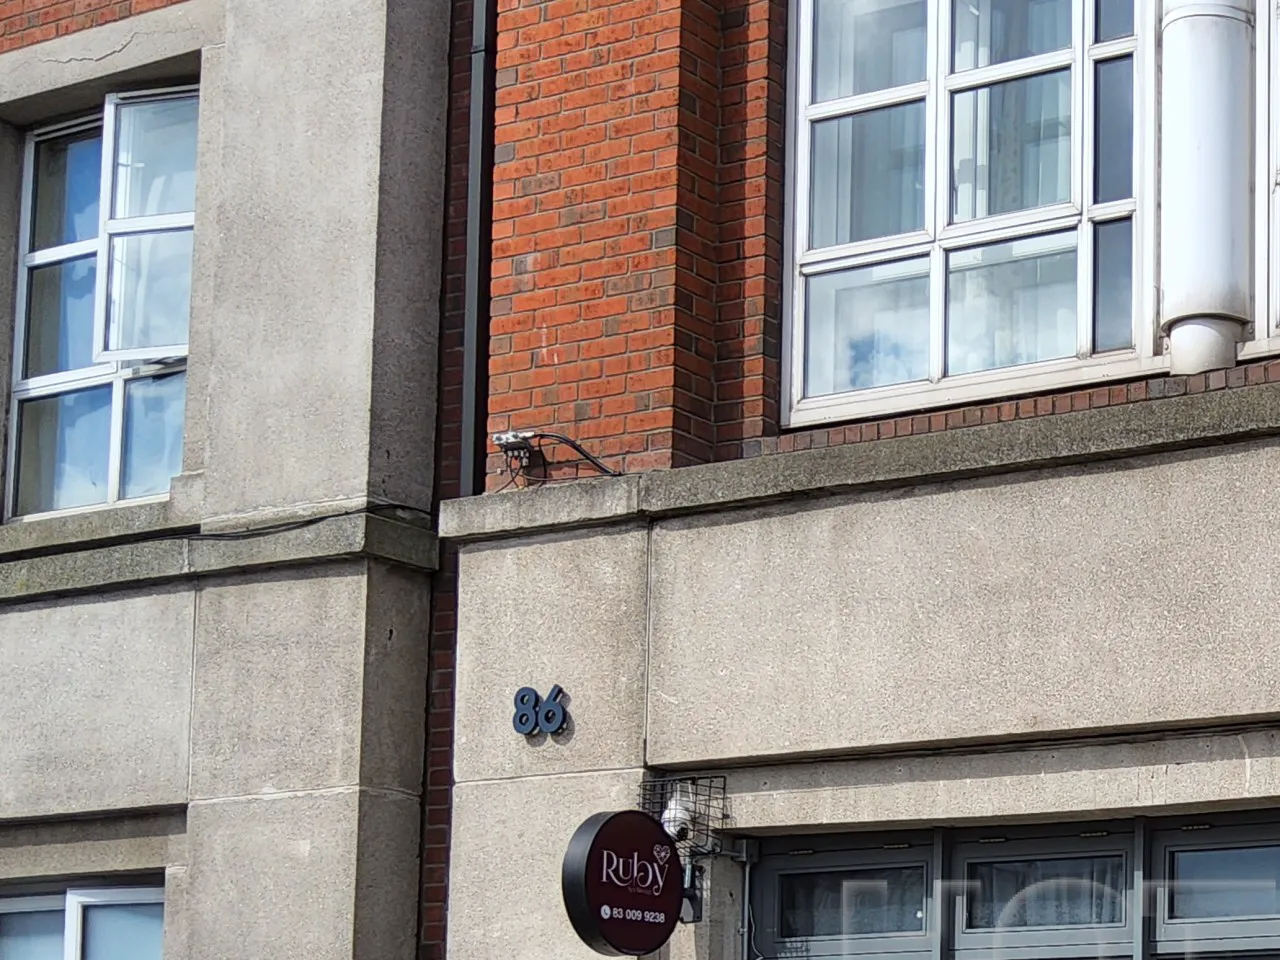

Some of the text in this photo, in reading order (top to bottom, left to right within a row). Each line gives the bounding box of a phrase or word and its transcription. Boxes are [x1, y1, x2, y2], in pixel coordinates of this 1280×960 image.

[512, 684, 567, 736] 86
[601, 850, 668, 896] Ruby
[613, 907, 665, 923] 83 009 9238
